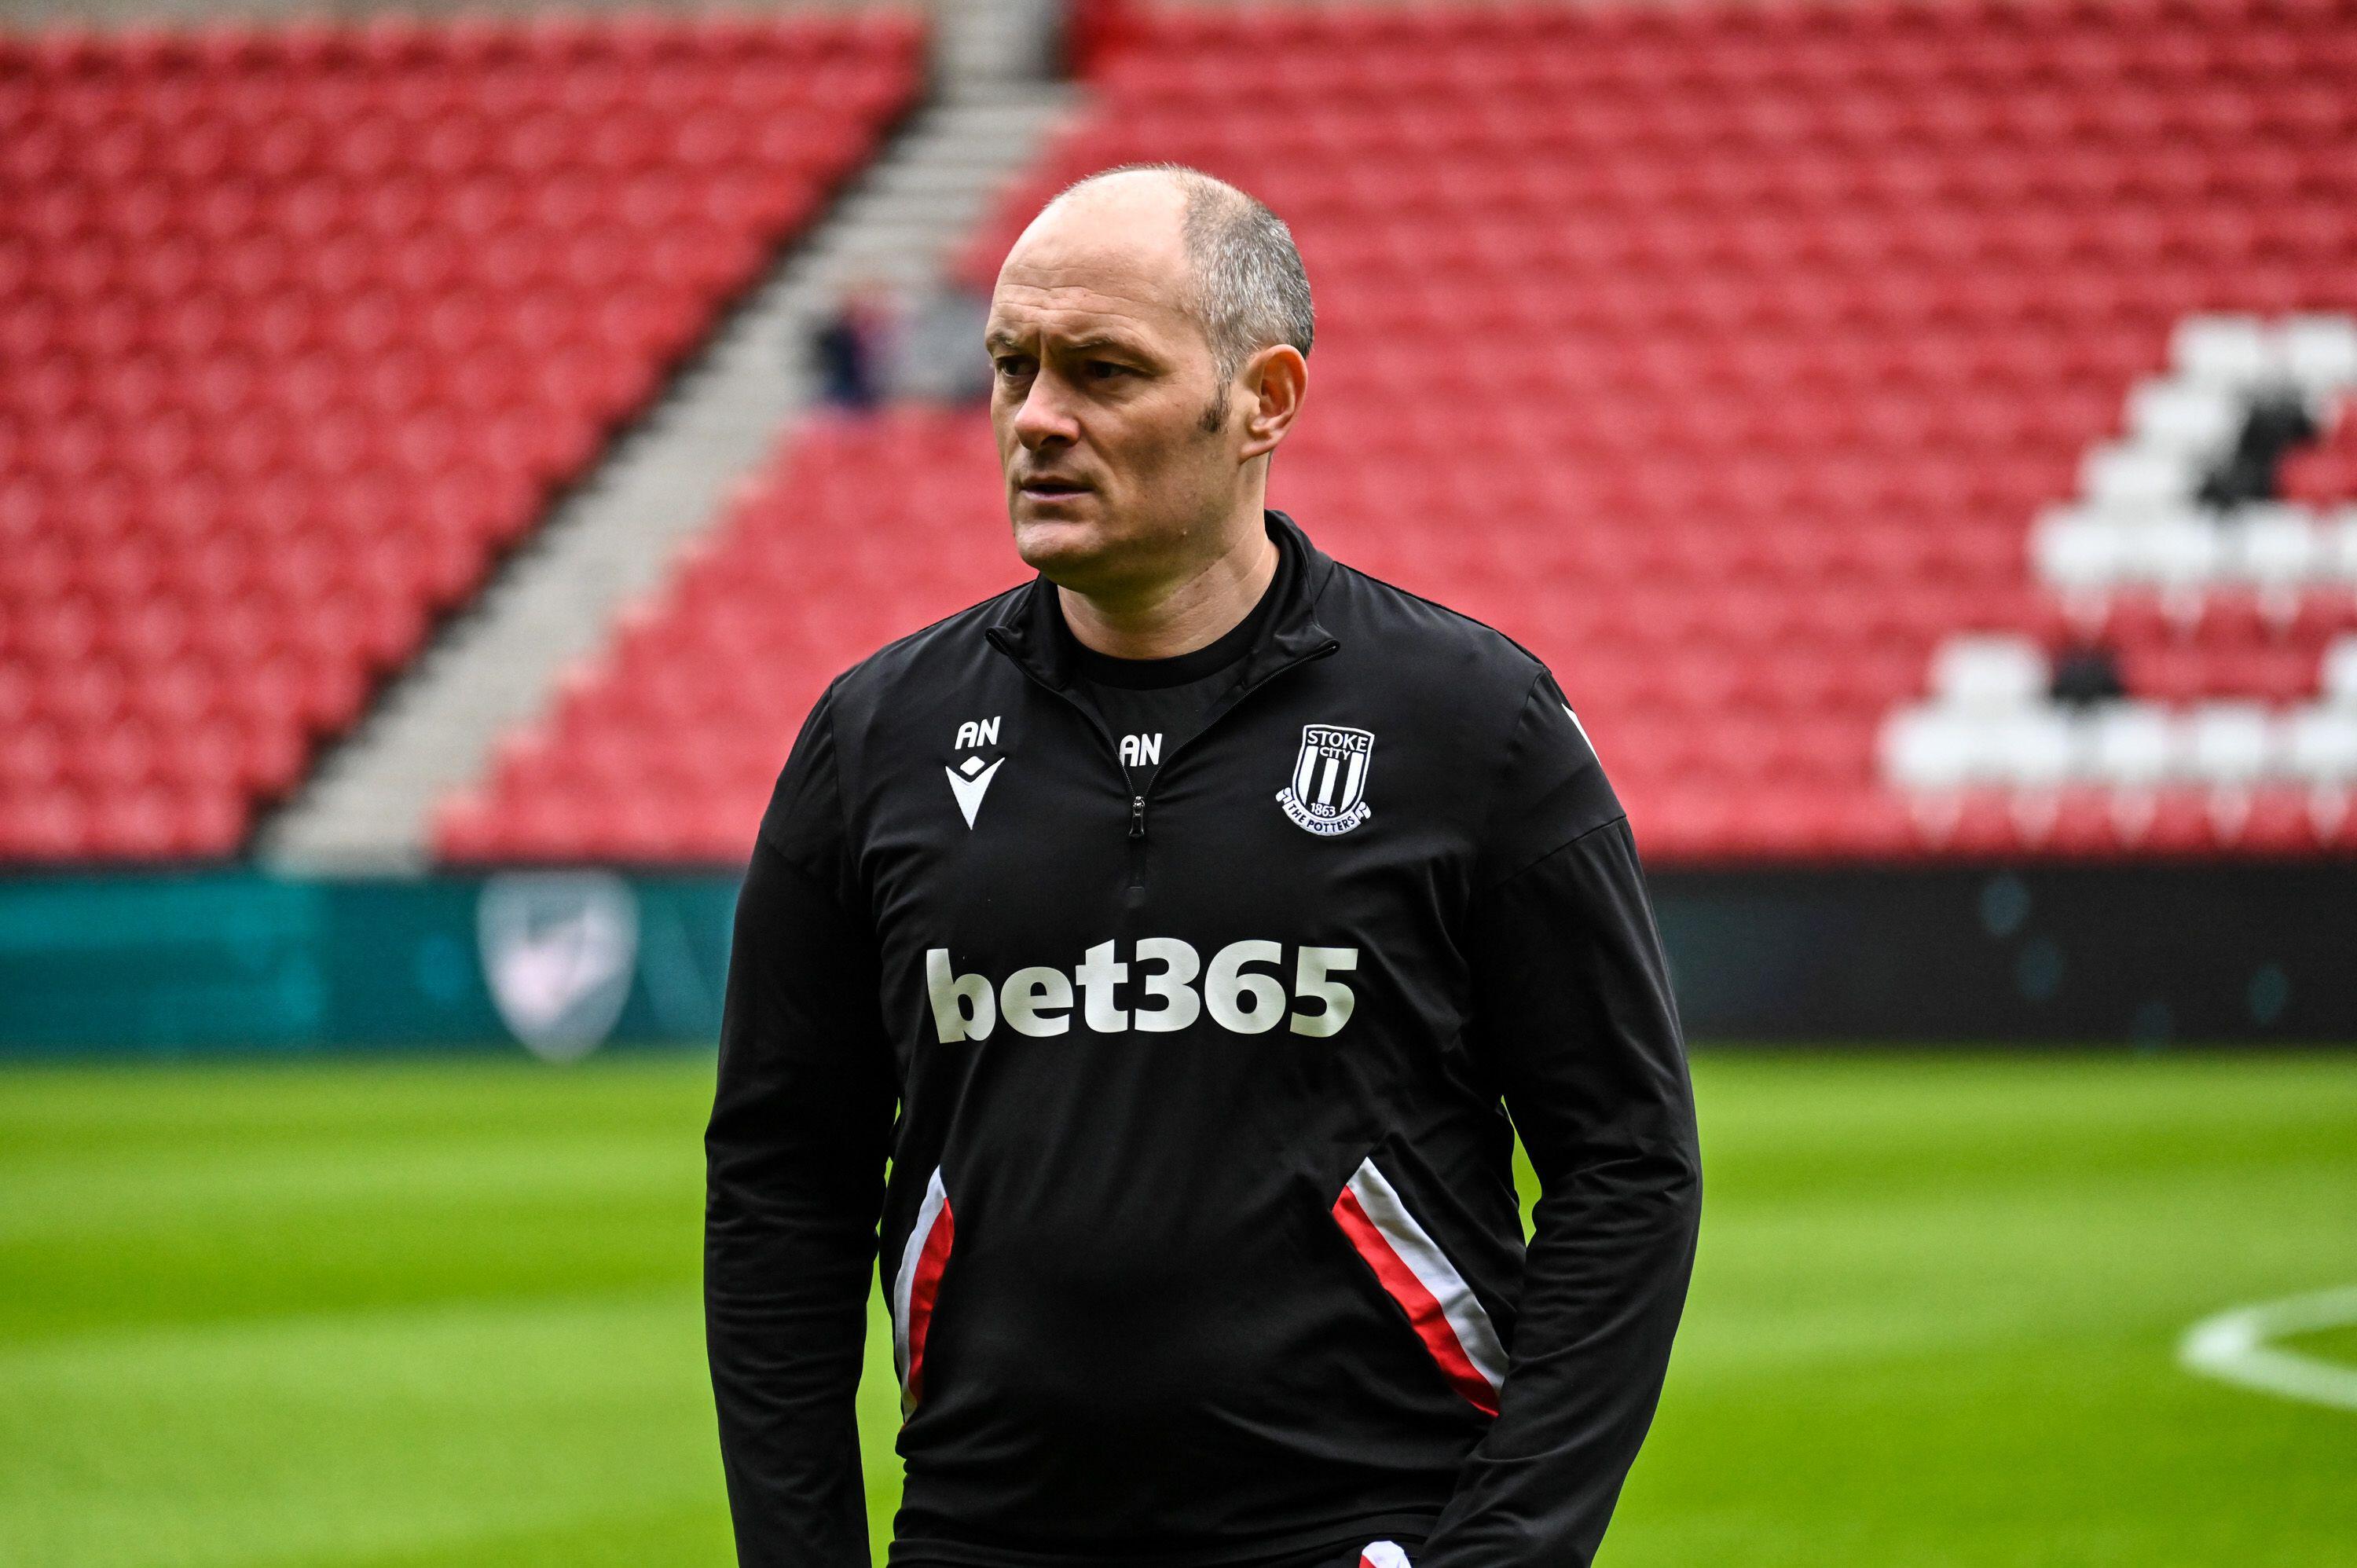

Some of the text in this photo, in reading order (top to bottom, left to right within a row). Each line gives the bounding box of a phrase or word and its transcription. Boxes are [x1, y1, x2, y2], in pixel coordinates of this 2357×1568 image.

[955, 716, 1001, 749] AN
[1307, 730, 1369, 753] STOKE
[1119, 733, 1163, 767] AN
[1319, 747, 1351, 760] CITY
[1288, 804, 1355, 833] THE POTTERS
[1310, 803, 1336, 817] 1863
[926, 937, 1358, 1044] bet365
